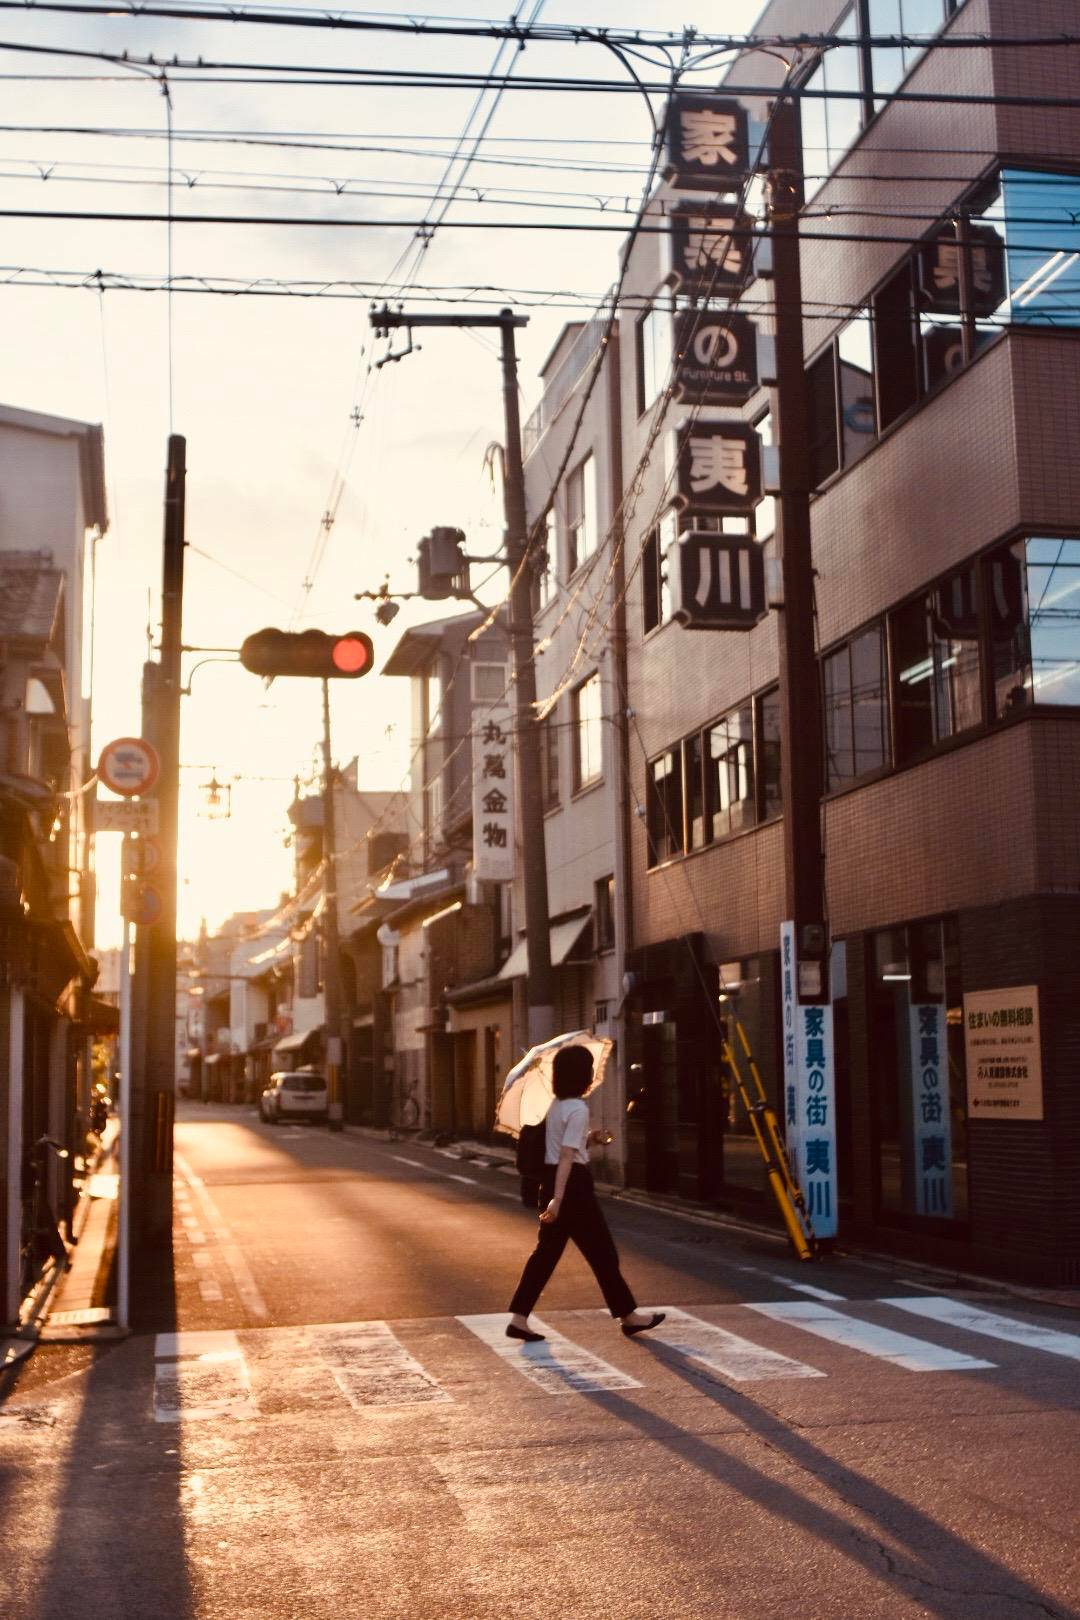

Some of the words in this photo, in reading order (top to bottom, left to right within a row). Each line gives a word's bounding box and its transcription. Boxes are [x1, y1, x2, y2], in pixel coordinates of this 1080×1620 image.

[683, 367, 732, 382] Furniture
[482, 719, 507, 848] 丸萬金物
[804, 1007, 827, 1126] 家具の街
[805, 1138, 830, 1218] 夷川
